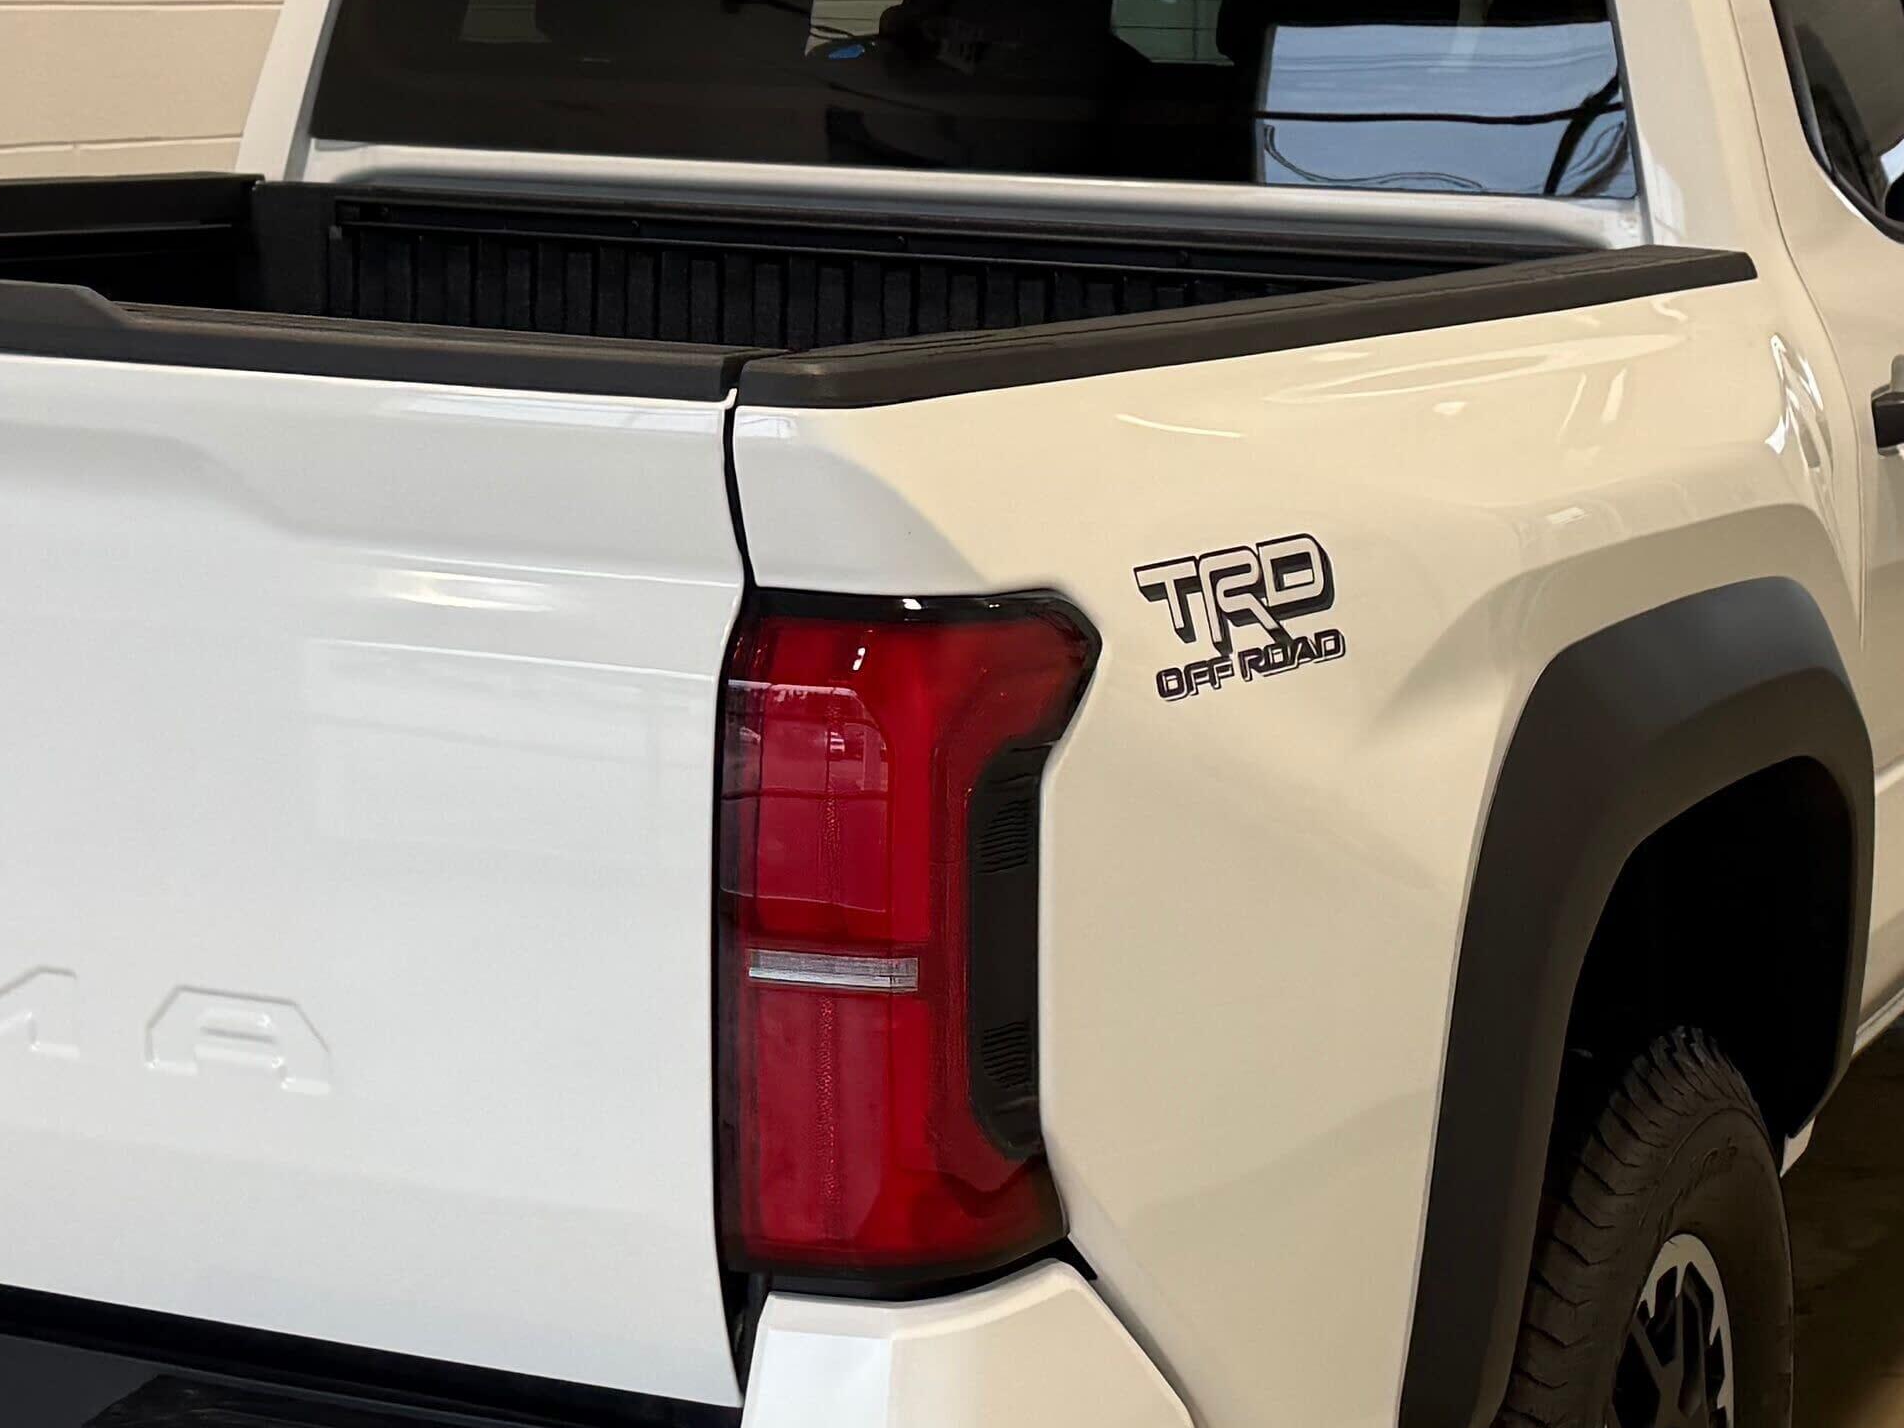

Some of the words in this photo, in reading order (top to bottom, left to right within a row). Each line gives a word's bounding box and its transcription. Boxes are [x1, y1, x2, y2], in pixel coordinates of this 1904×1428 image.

[1134, 533, 1334, 655] TRD
[1156, 655, 1234, 701] OFF
[1238, 629, 1345, 682] ROAD
